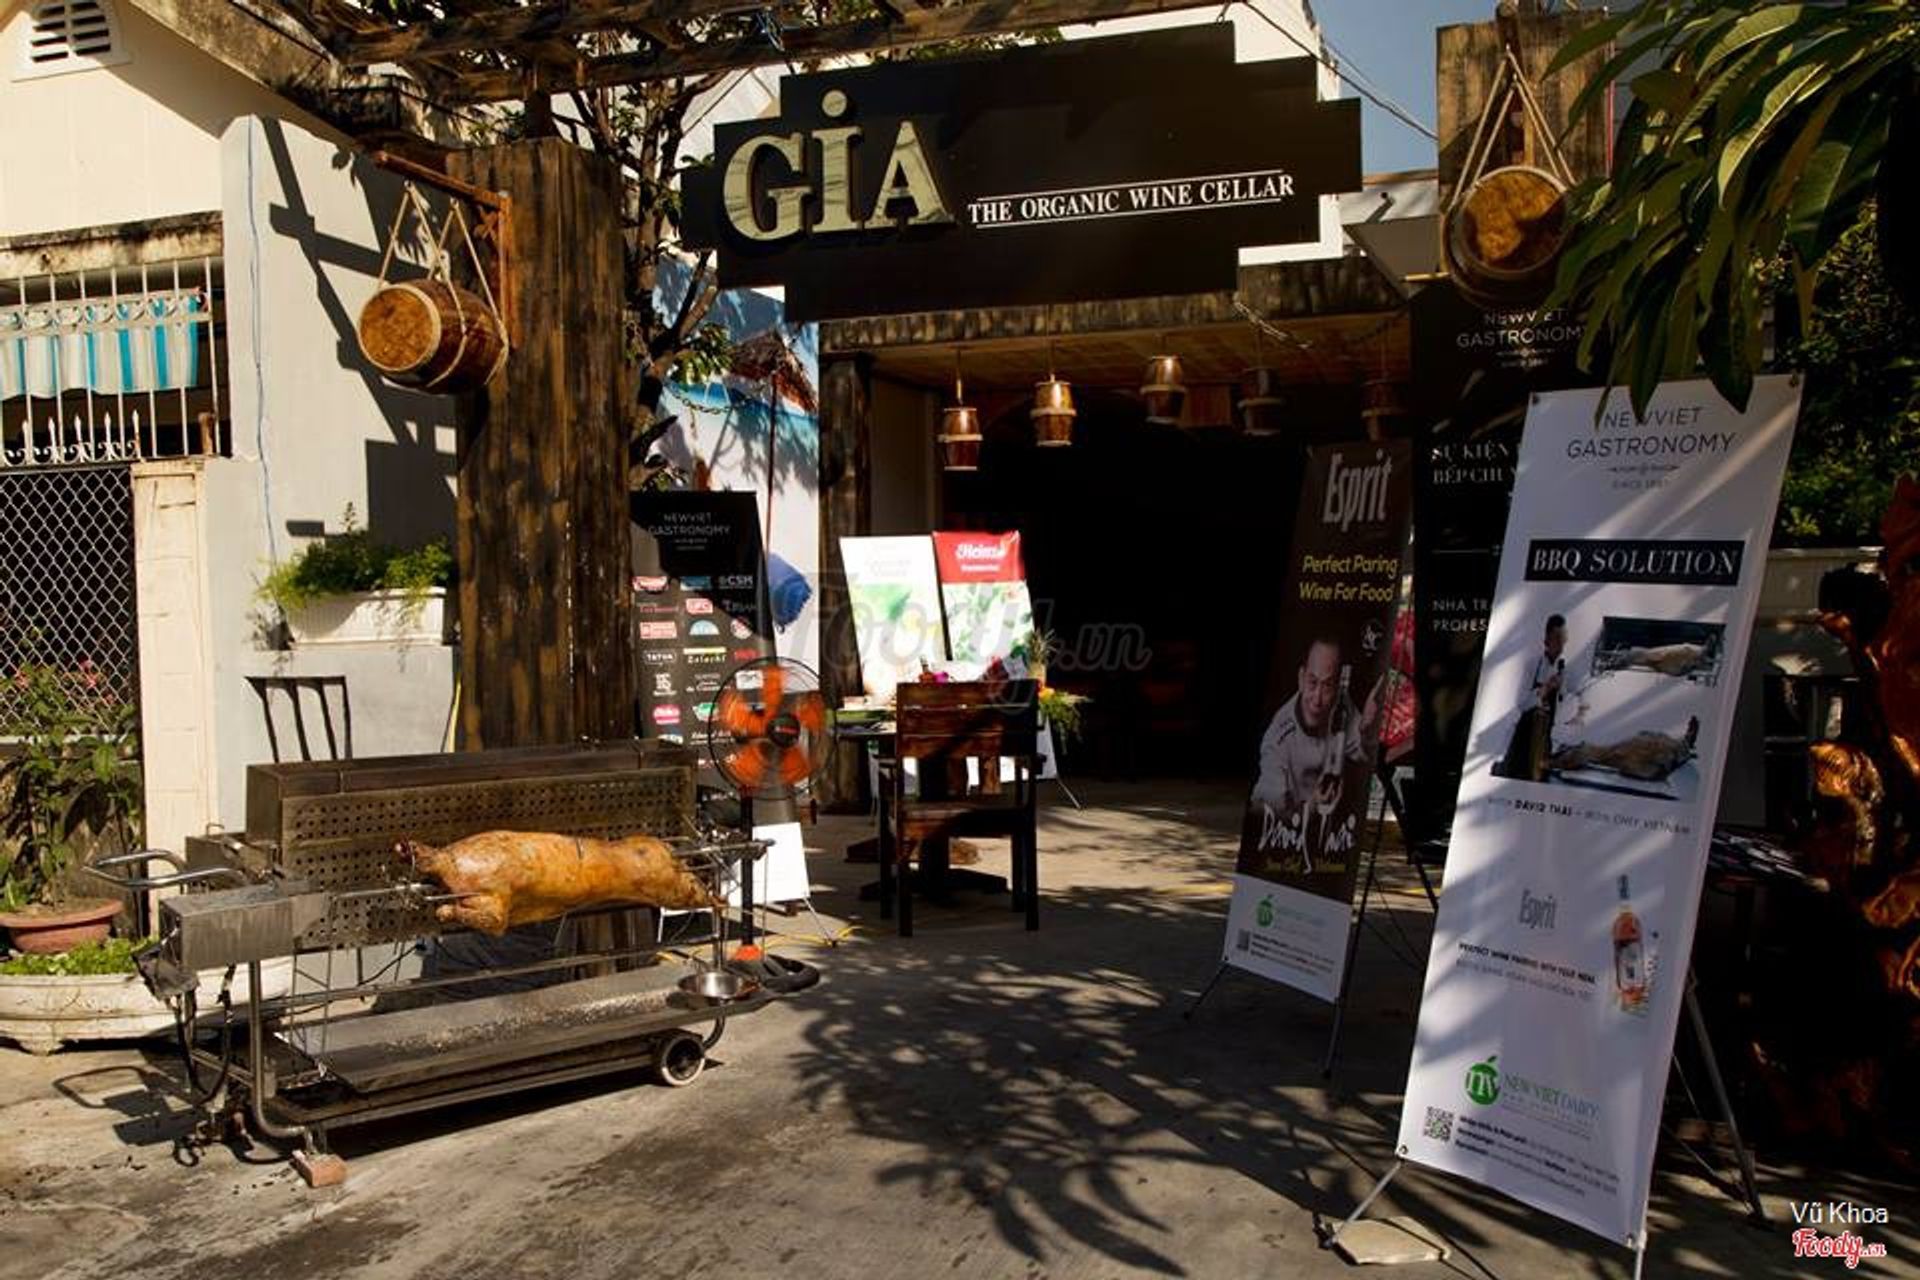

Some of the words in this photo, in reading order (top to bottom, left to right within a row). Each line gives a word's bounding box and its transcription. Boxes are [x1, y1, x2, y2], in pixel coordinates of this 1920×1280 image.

[967, 202, 1013, 224] THE
[1020, 190, 1121, 220] ORGANIC
[1128, 183, 1193, 210] WINE
[1199, 174, 1295, 204] CELLAR
[1567, 432, 1737, 459] GASTRONOMY
[1321, 448, 1394, 533] Esprit
[663, 512, 712, 524] NEWVIET
[647, 524, 731, 537] GASTRONOMY
[1301, 554, 1350, 574] Perfect
[1532, 548, 1582, 577] BBQ
[1588, 548, 1737, 576] SOLUTION
[1299, 581, 1333, 600] Wine
[1359, 582, 1396, 602] Food
[1514, 799, 1545, 814] DAVID
